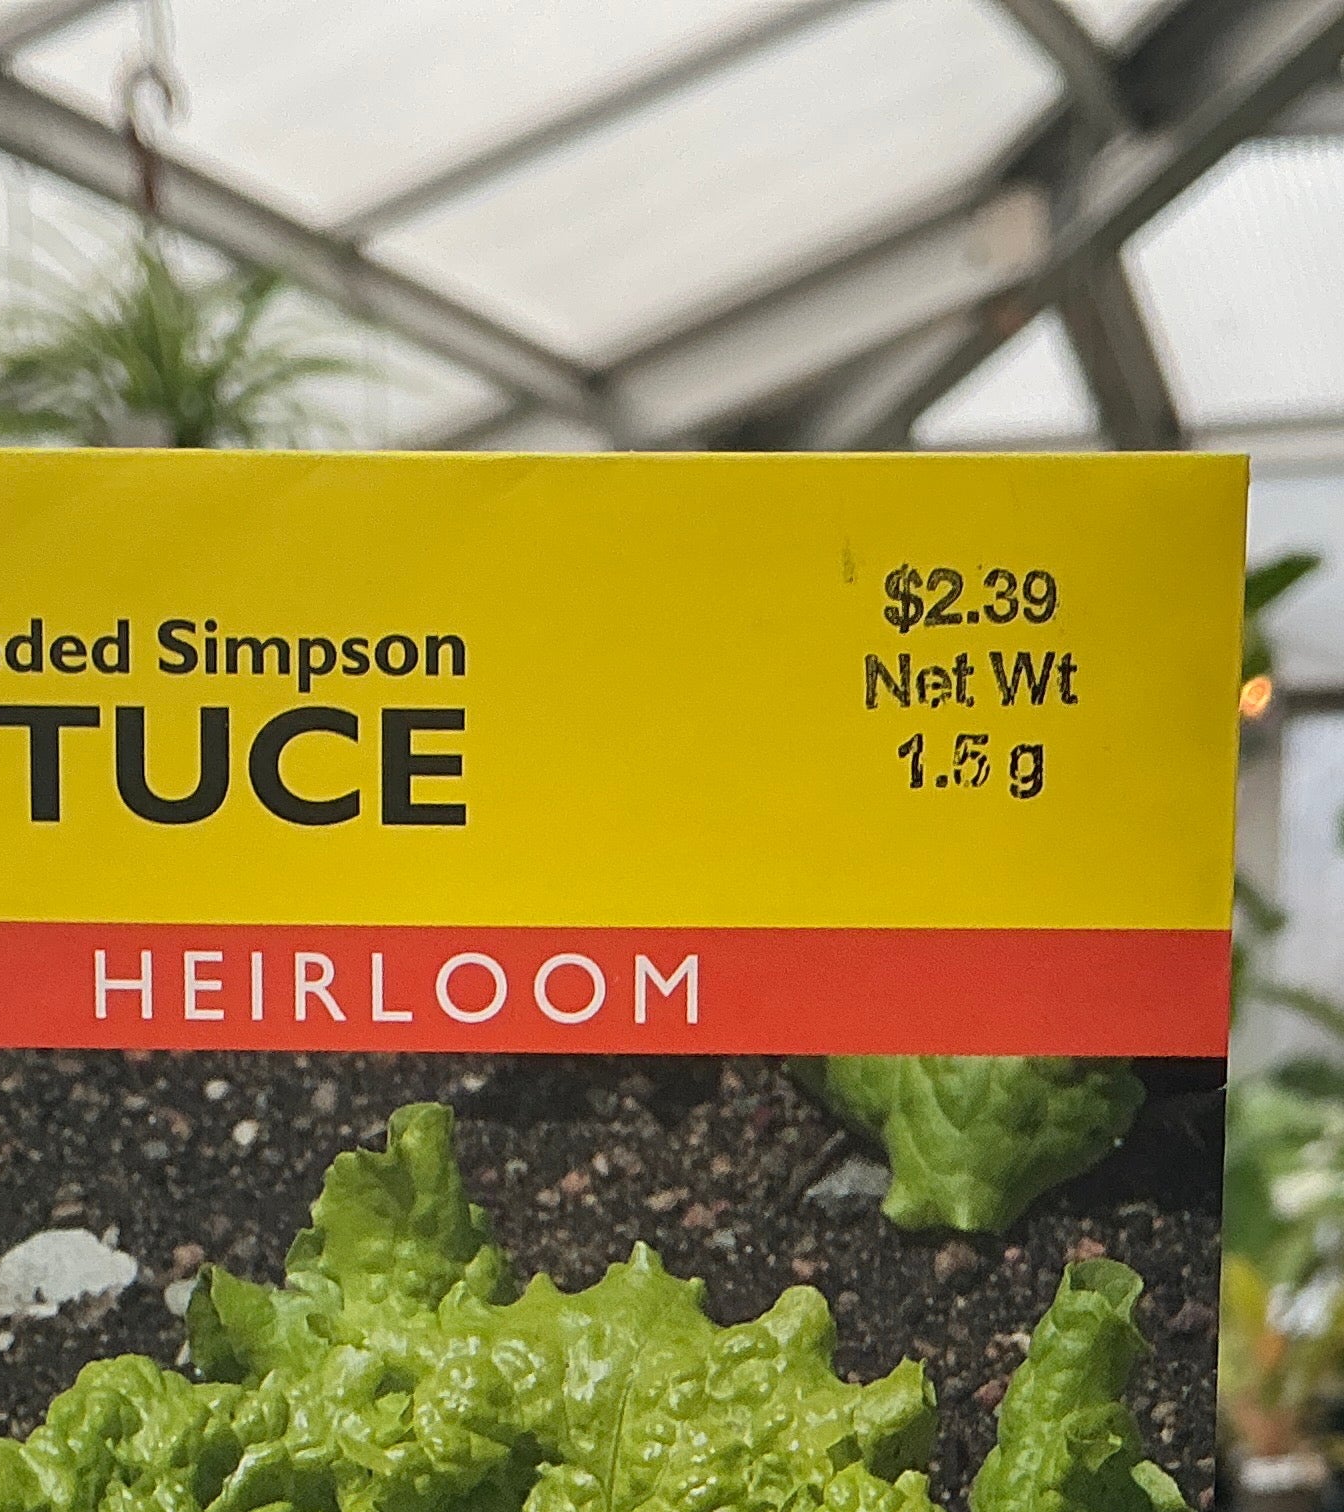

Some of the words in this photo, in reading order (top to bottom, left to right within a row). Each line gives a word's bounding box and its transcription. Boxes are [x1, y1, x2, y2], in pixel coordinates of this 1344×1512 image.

[884, 564, 1058, 633] $2.39
[158, 619, 467, 693] Simpson
[864, 652, 975, 709] Net
[989, 651, 1079, 706] Wt
[897, 732, 991, 789] 1.5
[1008, 743, 1045, 799] g
[94, 949, 706, 1027] HEIRLOOM
